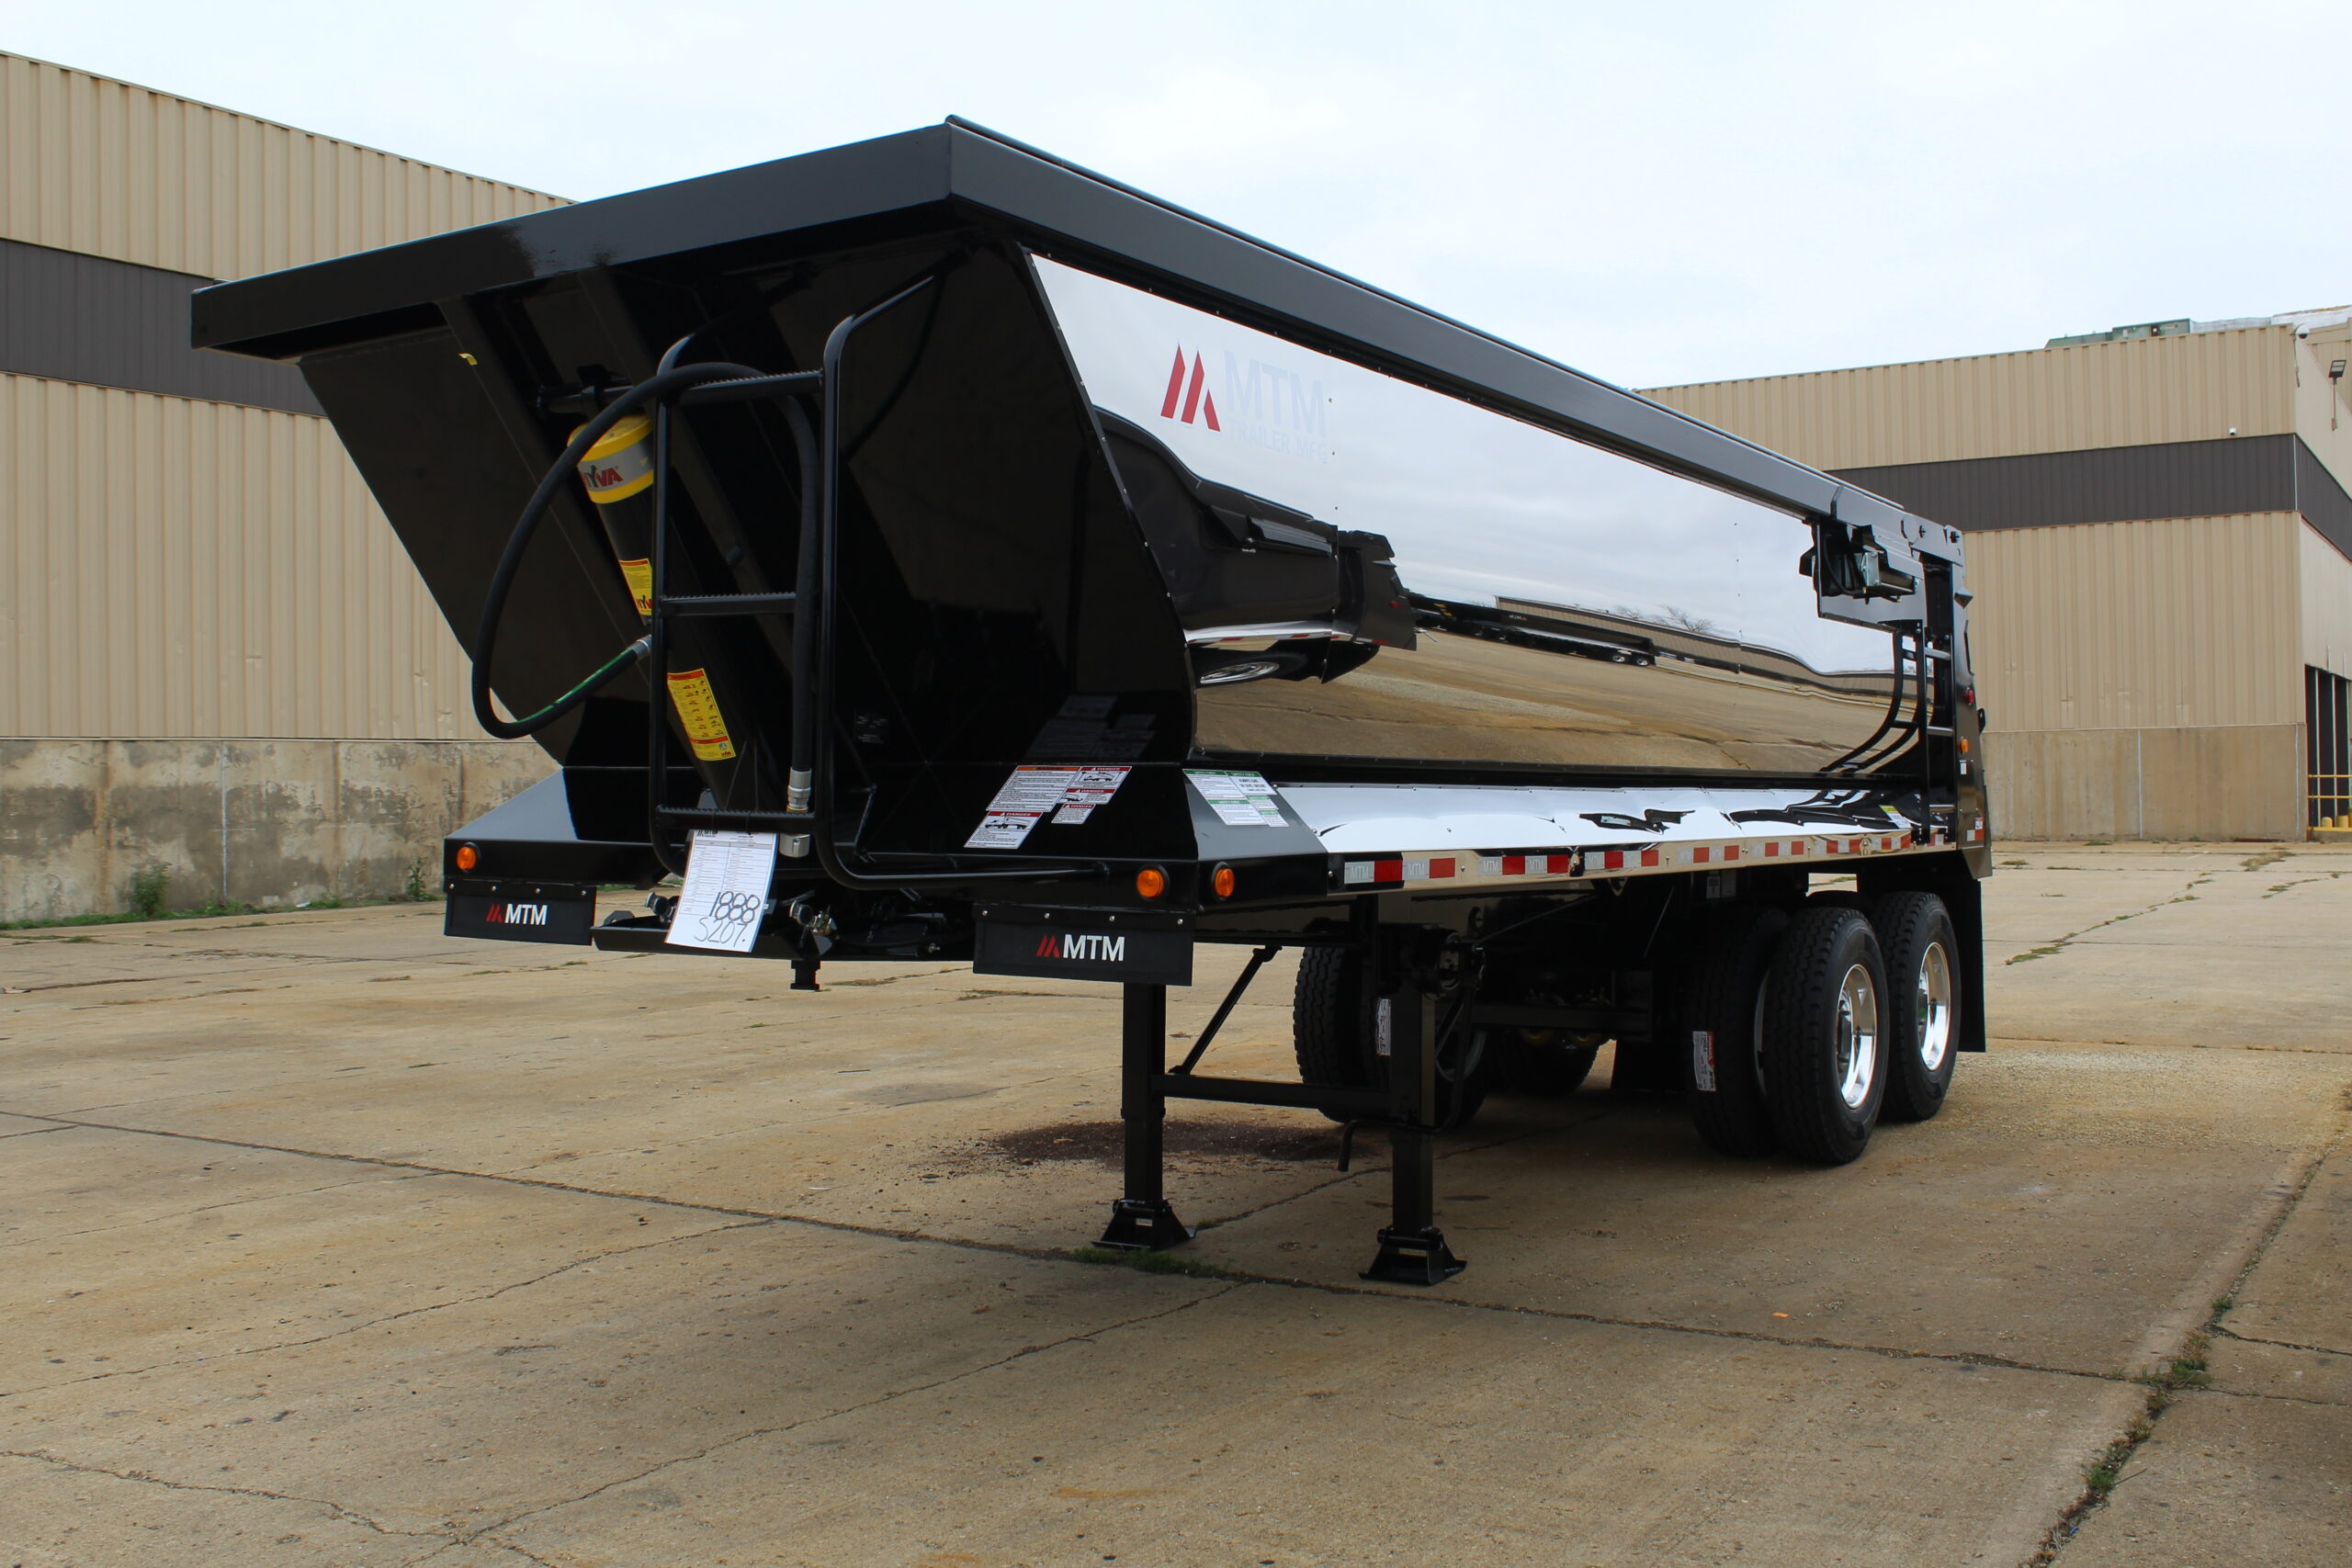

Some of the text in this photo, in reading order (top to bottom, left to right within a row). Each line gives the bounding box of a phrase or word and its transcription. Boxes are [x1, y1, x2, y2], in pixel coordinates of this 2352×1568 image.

[1224, 350, 1327, 437] MTM
[1227, 417, 1329, 464] TRAILER MFG
[1351, 865, 1369, 880] MTM
[1408, 863, 1425, 876] MTM
[504, 903, 548, 926] MTM
[709, 890, 761, 924] 1888
[1062, 933, 1125, 962] MTM
